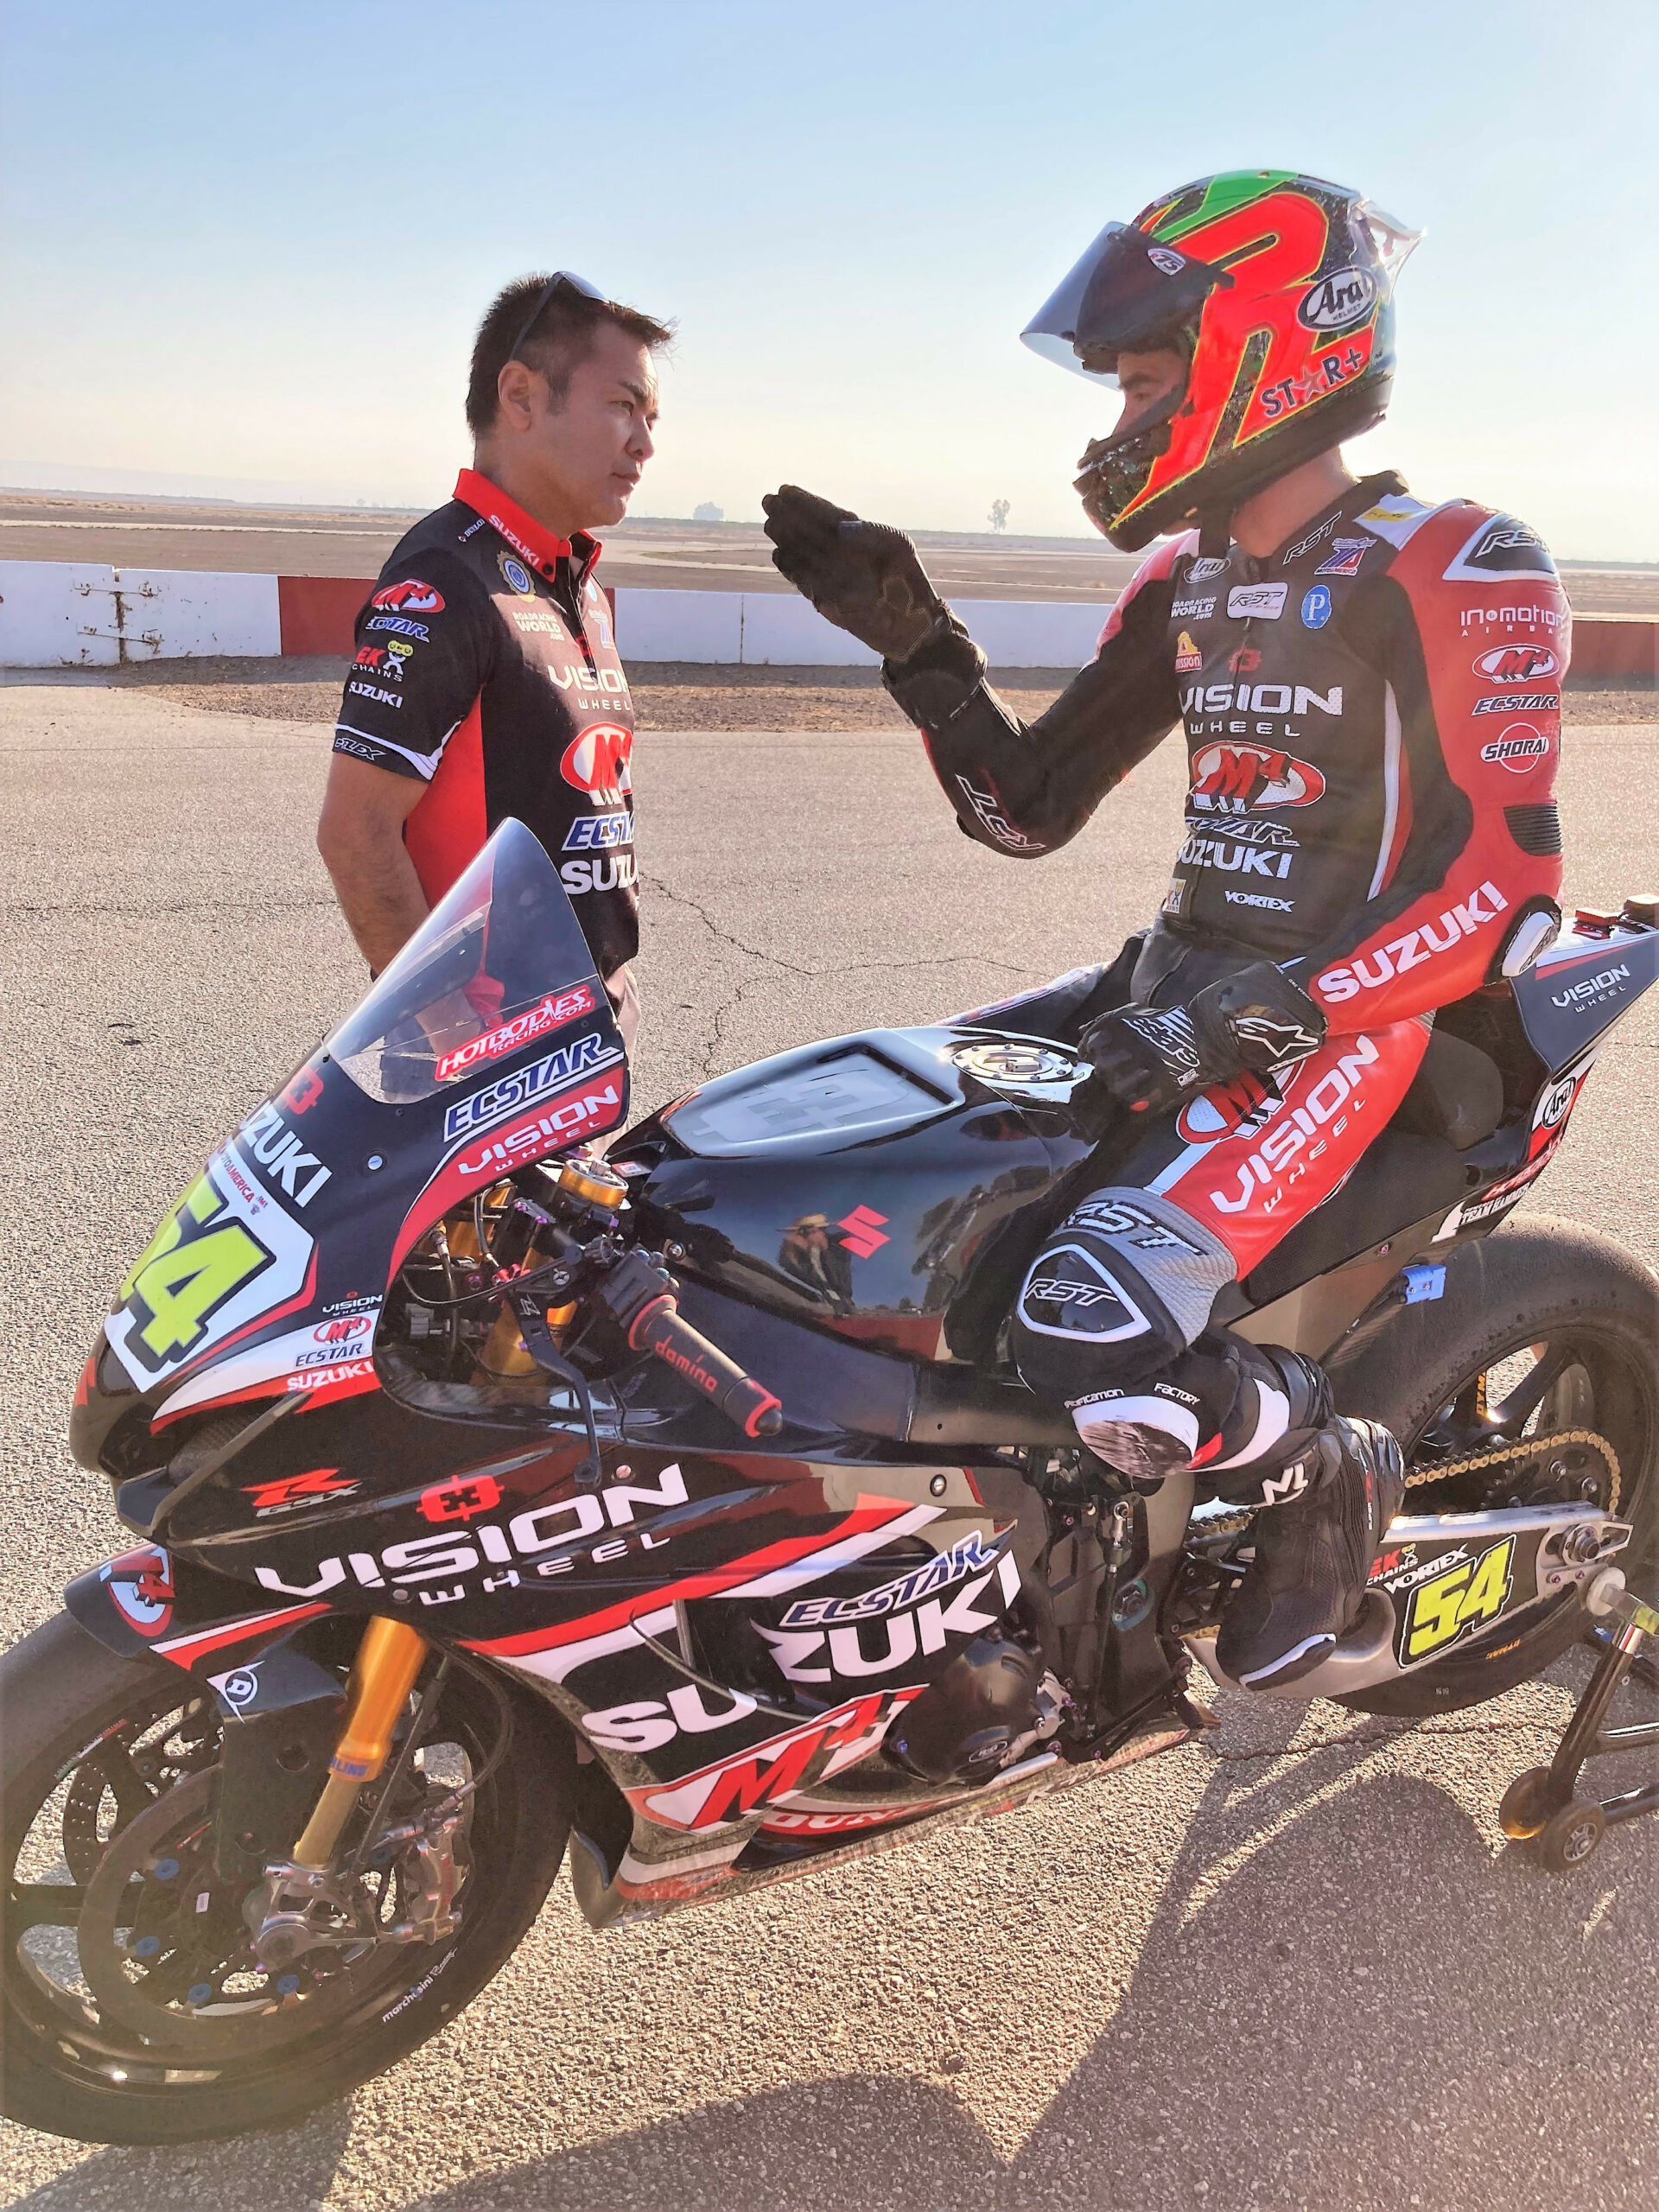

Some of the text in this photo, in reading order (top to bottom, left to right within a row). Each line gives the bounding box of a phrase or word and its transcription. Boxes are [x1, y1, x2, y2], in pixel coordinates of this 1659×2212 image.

[1307, 275, 1372, 323] Arai
[488, 514, 540, 567] SUZUKI
[1171, 604, 1215, 618] WORLD
[1230, 592, 1284, 607] RST
[516, 620, 561, 633] WORLD
[1461, 624, 1564, 639] AIRBA
[355, 646, 386, 666] EK
[353, 664, 404, 683] CHAINS
[578, 697, 631, 711] WHEEL
[1179, 683, 1343, 715] VISION
[1471, 695, 1559, 716] ECSTAR
[1190, 720, 1301, 737] WHEEL
[1485, 738, 1547, 760] SHORAI
[1192, 747, 1293, 814] M4
[560, 854, 640, 895] SUZU
[1224, 890, 1296, 912] VORTEX
[1318, 880, 1510, 1003] SUZUKI
[1551, 963, 1630, 1007] VISION
[1574, 986, 1626, 1013] WHEEL
[444, 1032, 621, 1143] ECSTAR
[458, 1085, 620, 1175] VISION
[1210, 1035, 1380, 1214] VISION
[494, 1122, 601, 1173] WHEEL
[1262, 1097, 1368, 1214] WHEEL
[1061, 1198, 1211, 1256] RST
[322, 1294, 383, 1313] VISION
[1025, 1277, 1119, 1306] RST
[333, 1306, 372, 1317] WHEEL
[296, 1343, 363, 1367] ECSTAR
[654, 1335, 718, 1393] domino
[287, 1360, 375, 1392] SUZUKI
[254, 1463, 690, 1597] VISION
[419, 1532, 671, 1606] WHEEL
[779, 1529, 1000, 1628] ECSTAR
[1366, 1557, 1420, 1586] CHAINS
[1369, 1548, 1402, 1578] EK
[1383, 1542, 1470, 1594] VORTEX
[1408, 1541, 1510, 1656] 54
